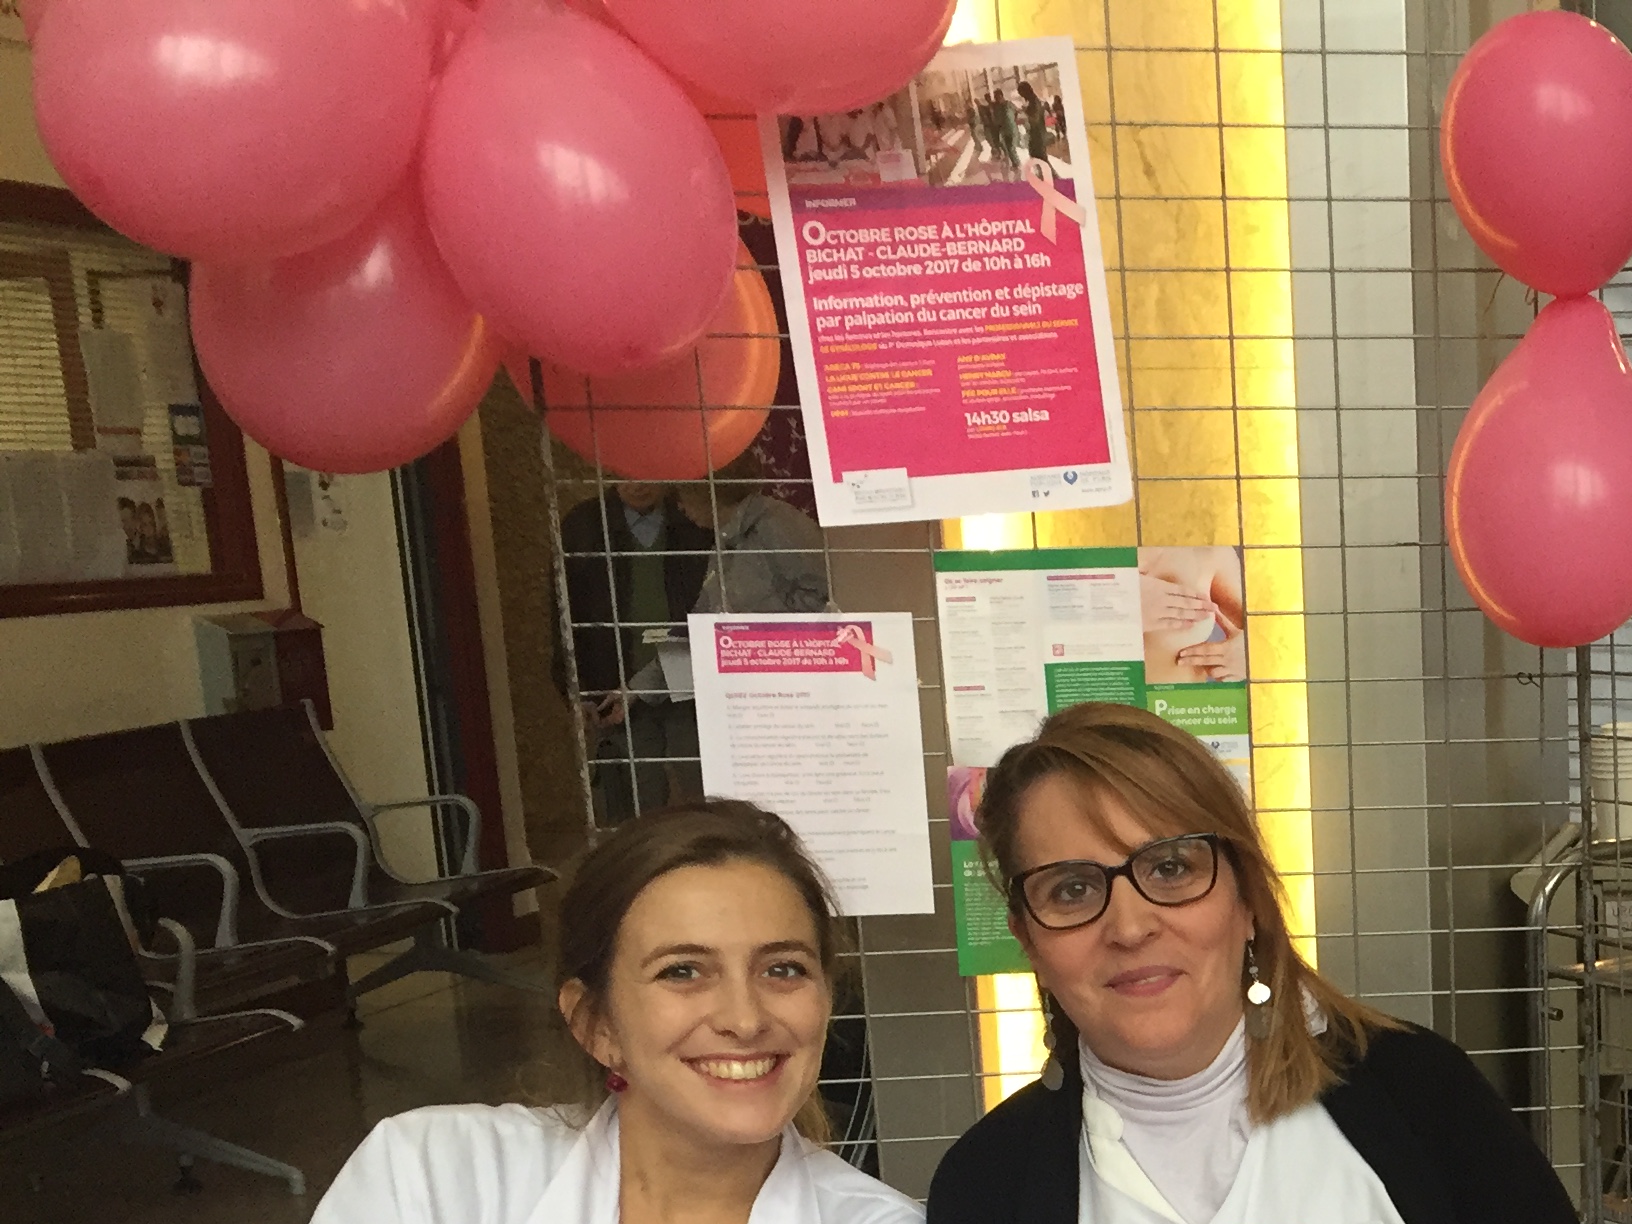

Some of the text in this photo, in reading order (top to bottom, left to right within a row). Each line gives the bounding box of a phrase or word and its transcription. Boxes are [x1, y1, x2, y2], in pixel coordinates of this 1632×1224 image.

[802, 218, 1035, 245] OCTOBRE ROSE À L'HÔPITAL
[805, 237, 1024, 263] BICHAT CLAUDE-BERNARD
[909, 289, 991, 308] prévention
[994, 286, 1010, 305] et
[1013, 282, 1083, 303] dépistage
[816, 302, 1041, 332] par palpation du cancer du sein
[964, 407, 1049, 426] 14h30 salsa
